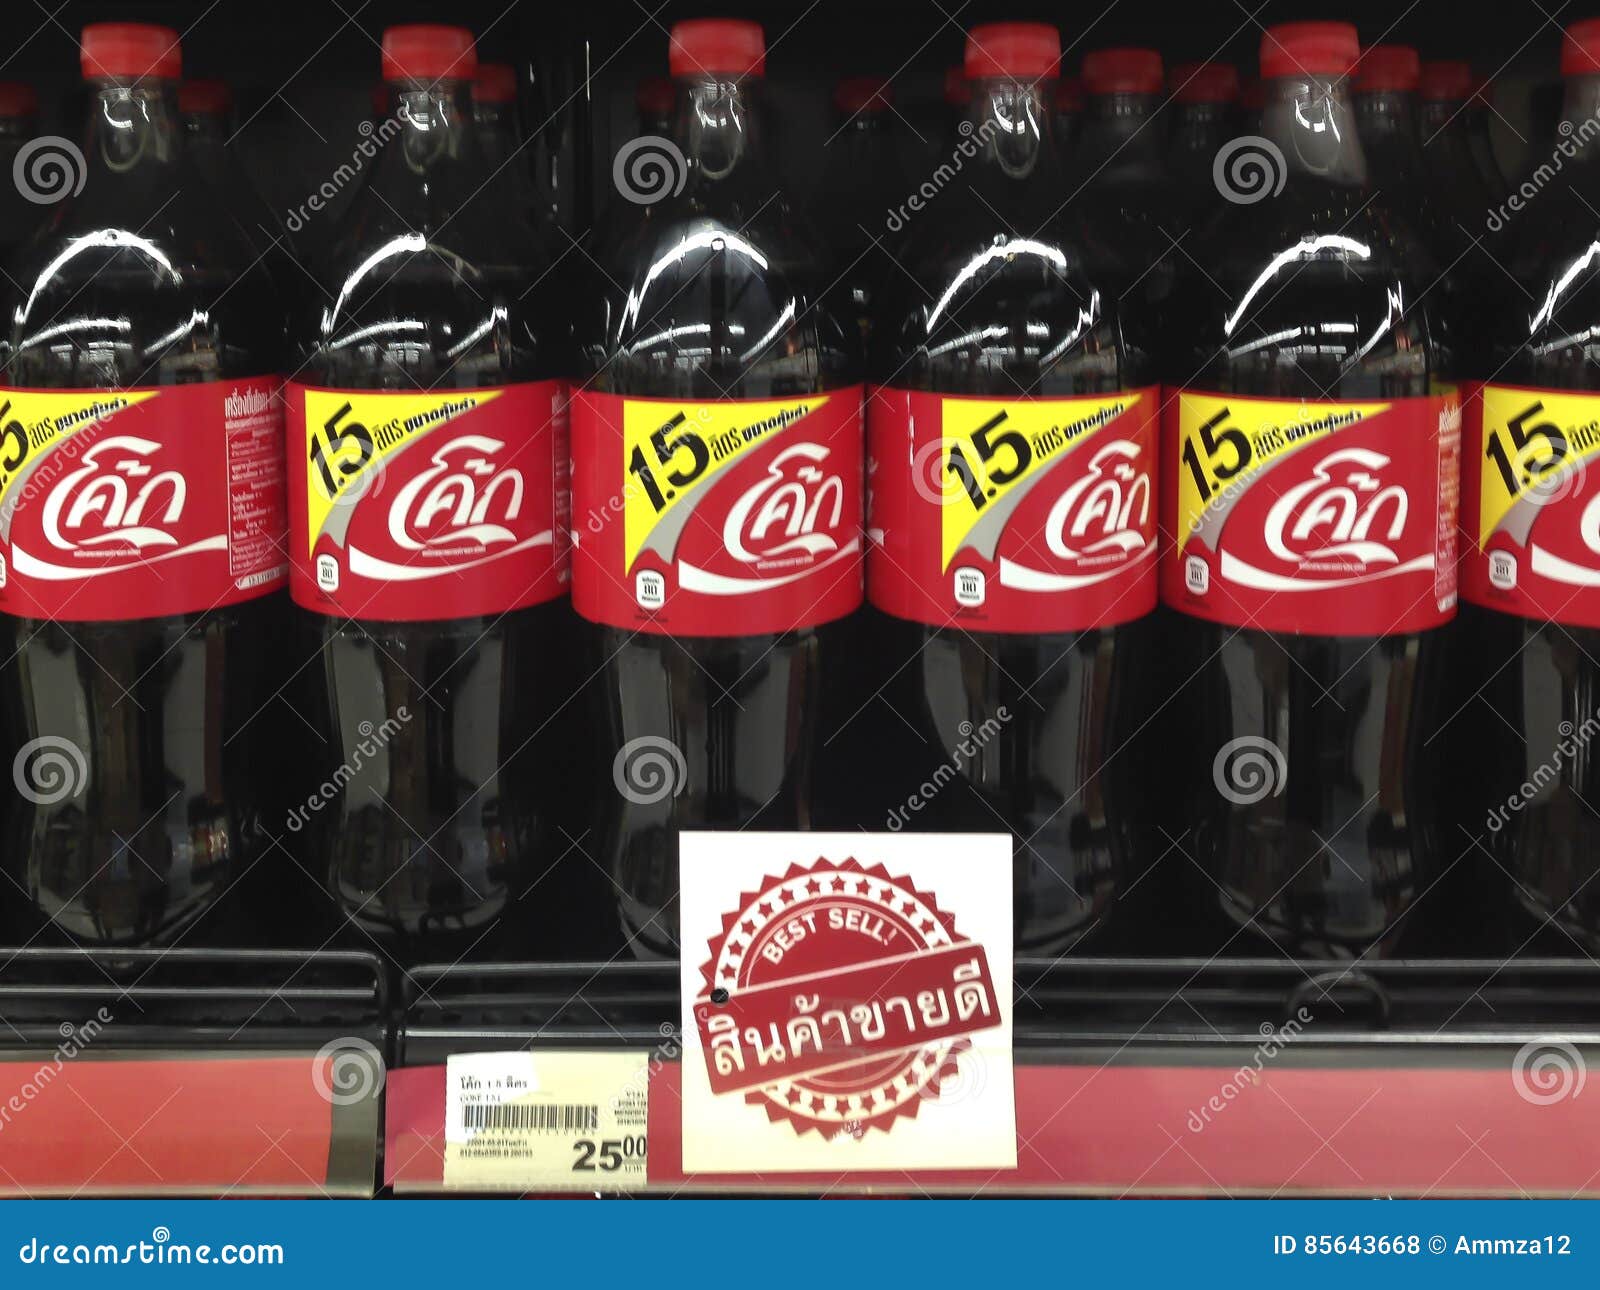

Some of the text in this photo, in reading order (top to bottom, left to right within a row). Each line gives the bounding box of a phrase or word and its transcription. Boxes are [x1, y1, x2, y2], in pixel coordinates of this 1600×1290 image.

[0, 399, 28, 492] .5
[29, 416, 55, 449] ลิตร
[310, 401, 374, 500] 1.5
[372, 417, 404, 451] ลิตร
[629, 411, 710, 514] 1.5
[710, 427, 742, 462] ลิตร
[947, 409, 1032, 512] 1.5
[1032, 425, 1063, 460] ลิตร
[1182, 406, 1252, 504] 1.5
[1485, 400, 1569, 499] 1.5
[762, 908, 898, 965] BEST SELL!
[707, 958, 991, 1077] สินค้าขายดี
